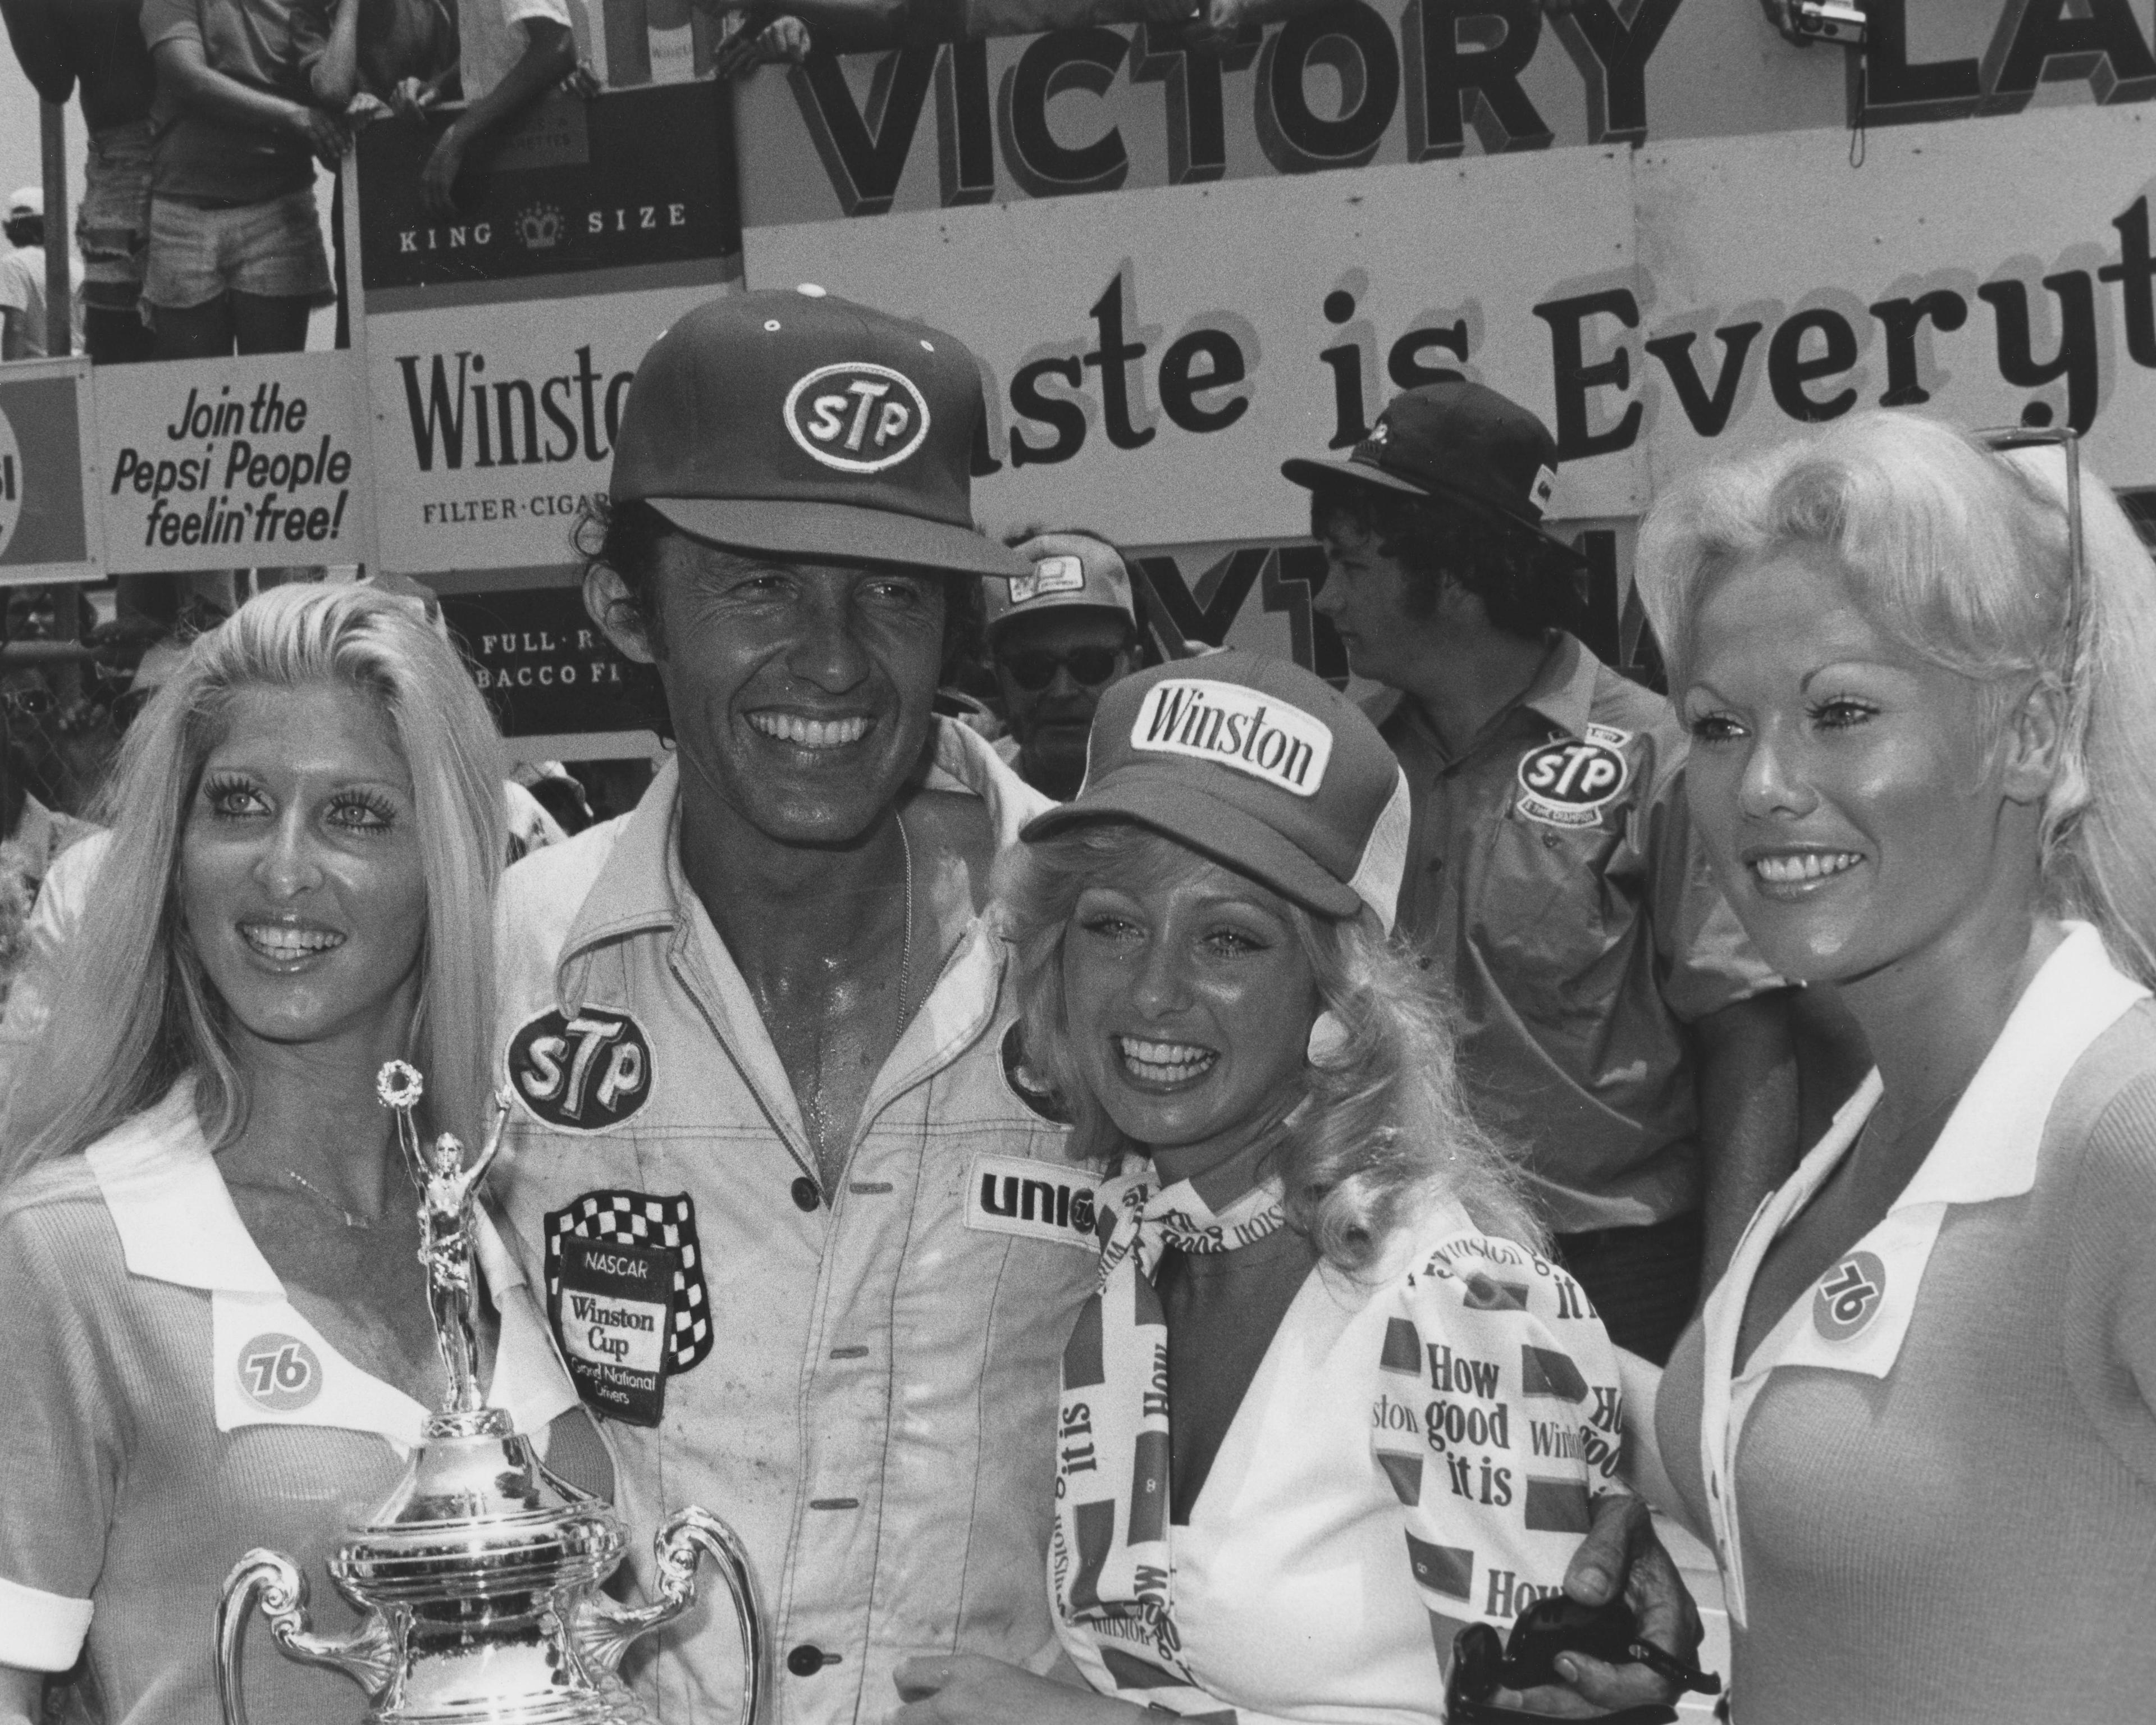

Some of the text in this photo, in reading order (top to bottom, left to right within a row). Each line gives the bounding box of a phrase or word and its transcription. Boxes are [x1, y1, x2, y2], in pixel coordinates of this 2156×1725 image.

[787, 0, 1683, 218] VICTORY
[400, 204, 686, 253] KING SIZE
[970, 264, 1251, 476] ste
[167, 381, 308, 440] Join the
[395, 344, 634, 472] Winsto
[807, 379, 910, 451] STP
[111, 434, 351, 500] Pepsi People
[477, 665, 576, 689] BACCO
[1147, 687, 1313, 786] Winston
[1528, 746, 1616, 795] STP
[521, 1019, 647, 1120] STP
[584, 1252, 650, 1279] NASCAR
[1819, 1260, 1879, 1325] 76
[570, 1294, 655, 1332] Winston
[245, 1343, 312, 1397] 76
[588, 1325, 630, 1362] Cup
[571, 1357, 656, 1391] Grand National
[594, 1380, 631, 1405] Drivers
[1427, 1343, 1500, 1399] How
[1372, 1394, 1420, 1434] ston
[1425, 1400, 1510, 1453] good
[1446, 1452, 1513, 1506] it is
